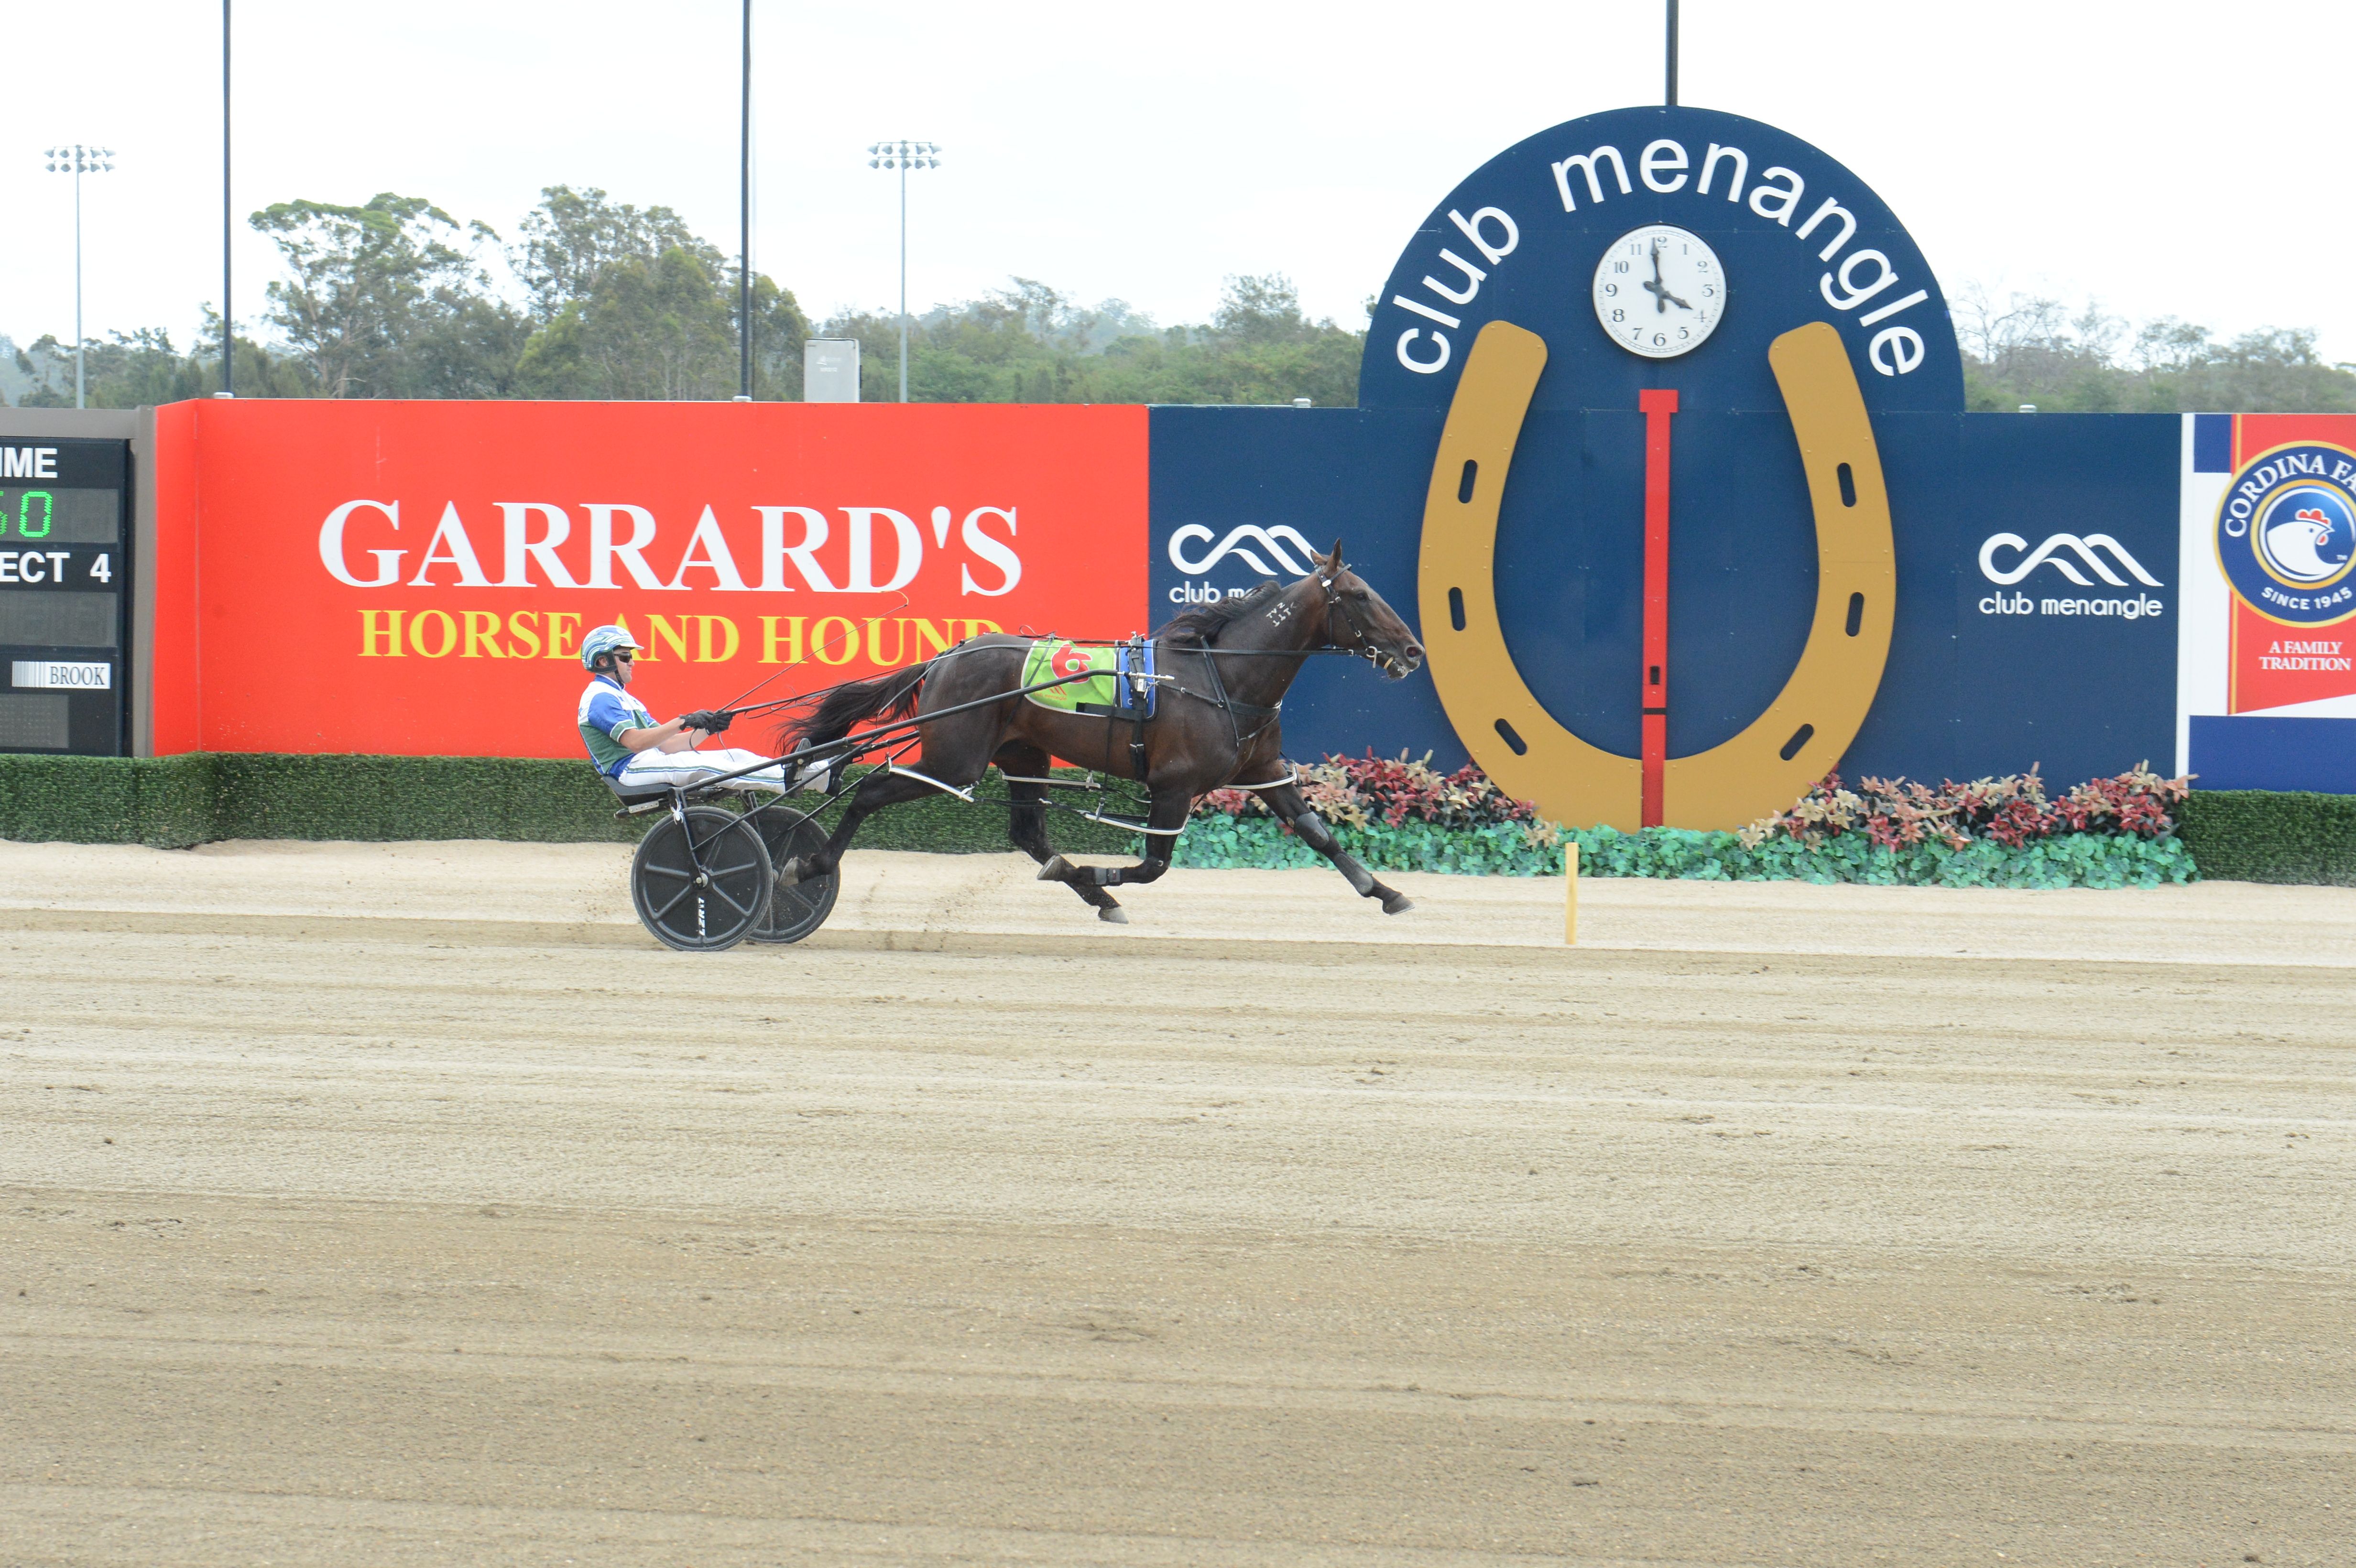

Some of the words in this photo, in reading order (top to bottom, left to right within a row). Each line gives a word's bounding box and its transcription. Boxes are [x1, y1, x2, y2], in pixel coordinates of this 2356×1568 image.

[1630, 244, 1642, 255] 11
[1682, 244, 1688, 255] 1
[1396, 206, 1521, 375] club
[1551, 138, 1930, 377] menangle
[1614, 261, 1629, 273] 10
[1697, 261, 1708, 273] 2
[1605, 283, 1617, 297] 9
[1613, 309, 1625, 322] 8
[1693, 310, 1707, 323] 4
[1633, 327, 1644, 340] 7
[1654, 333, 1666, 347] 6
[1678, 327, 1689, 339] 5
[2225, 454, 2327, 537] CORDINA
[0, 491, 53, 538] 0
[318, 500, 1022, 596] GARRARD'S
[89, 554, 112, 583] 4
[1169, 581, 1221, 603] club
[2261, 587, 2310, 610] SINCE
[2313, 587, 2353, 609] 1945
[1978, 591, 2034, 615] club
[2041, 593, 2163, 620] menangle
[357, 610, 582, 659] HORSE
[2268, 641, 2282, 653] A
[2283, 641, 2343, 654] FAMILY
[2258, 656, 2352, 671] TRADITION
[50, 666, 105, 685] BROOK
